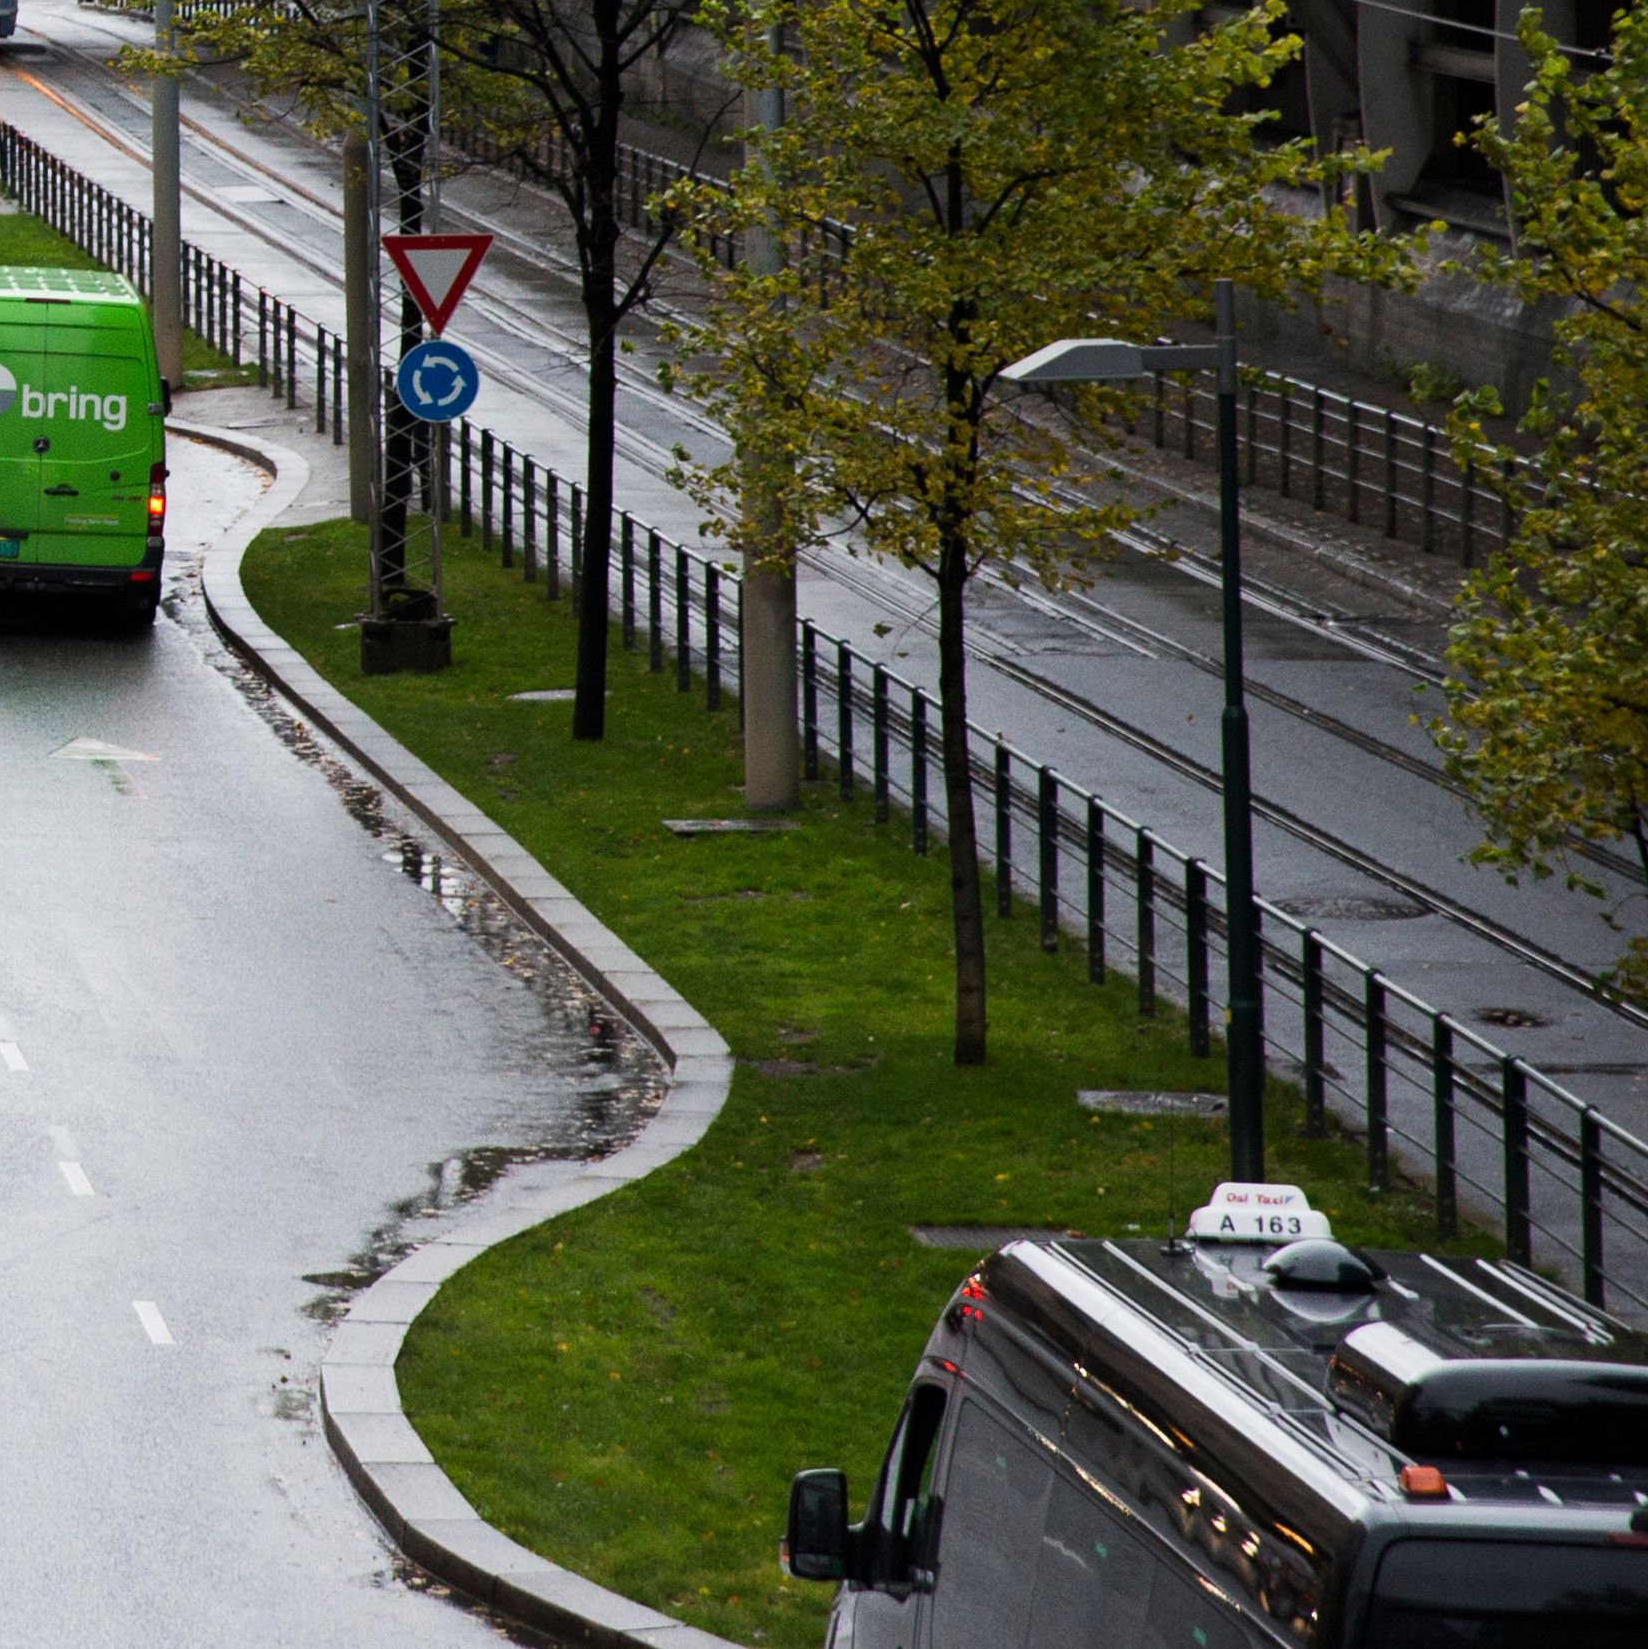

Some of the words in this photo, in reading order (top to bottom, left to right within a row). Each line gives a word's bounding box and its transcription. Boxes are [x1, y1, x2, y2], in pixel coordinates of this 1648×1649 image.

[21, 383, 127, 431] bring
[1255, 1193, 1283, 1205] Taxi
[1220, 1214, 1235, 1232] A
[1253, 1215, 1302, 1234] 163
